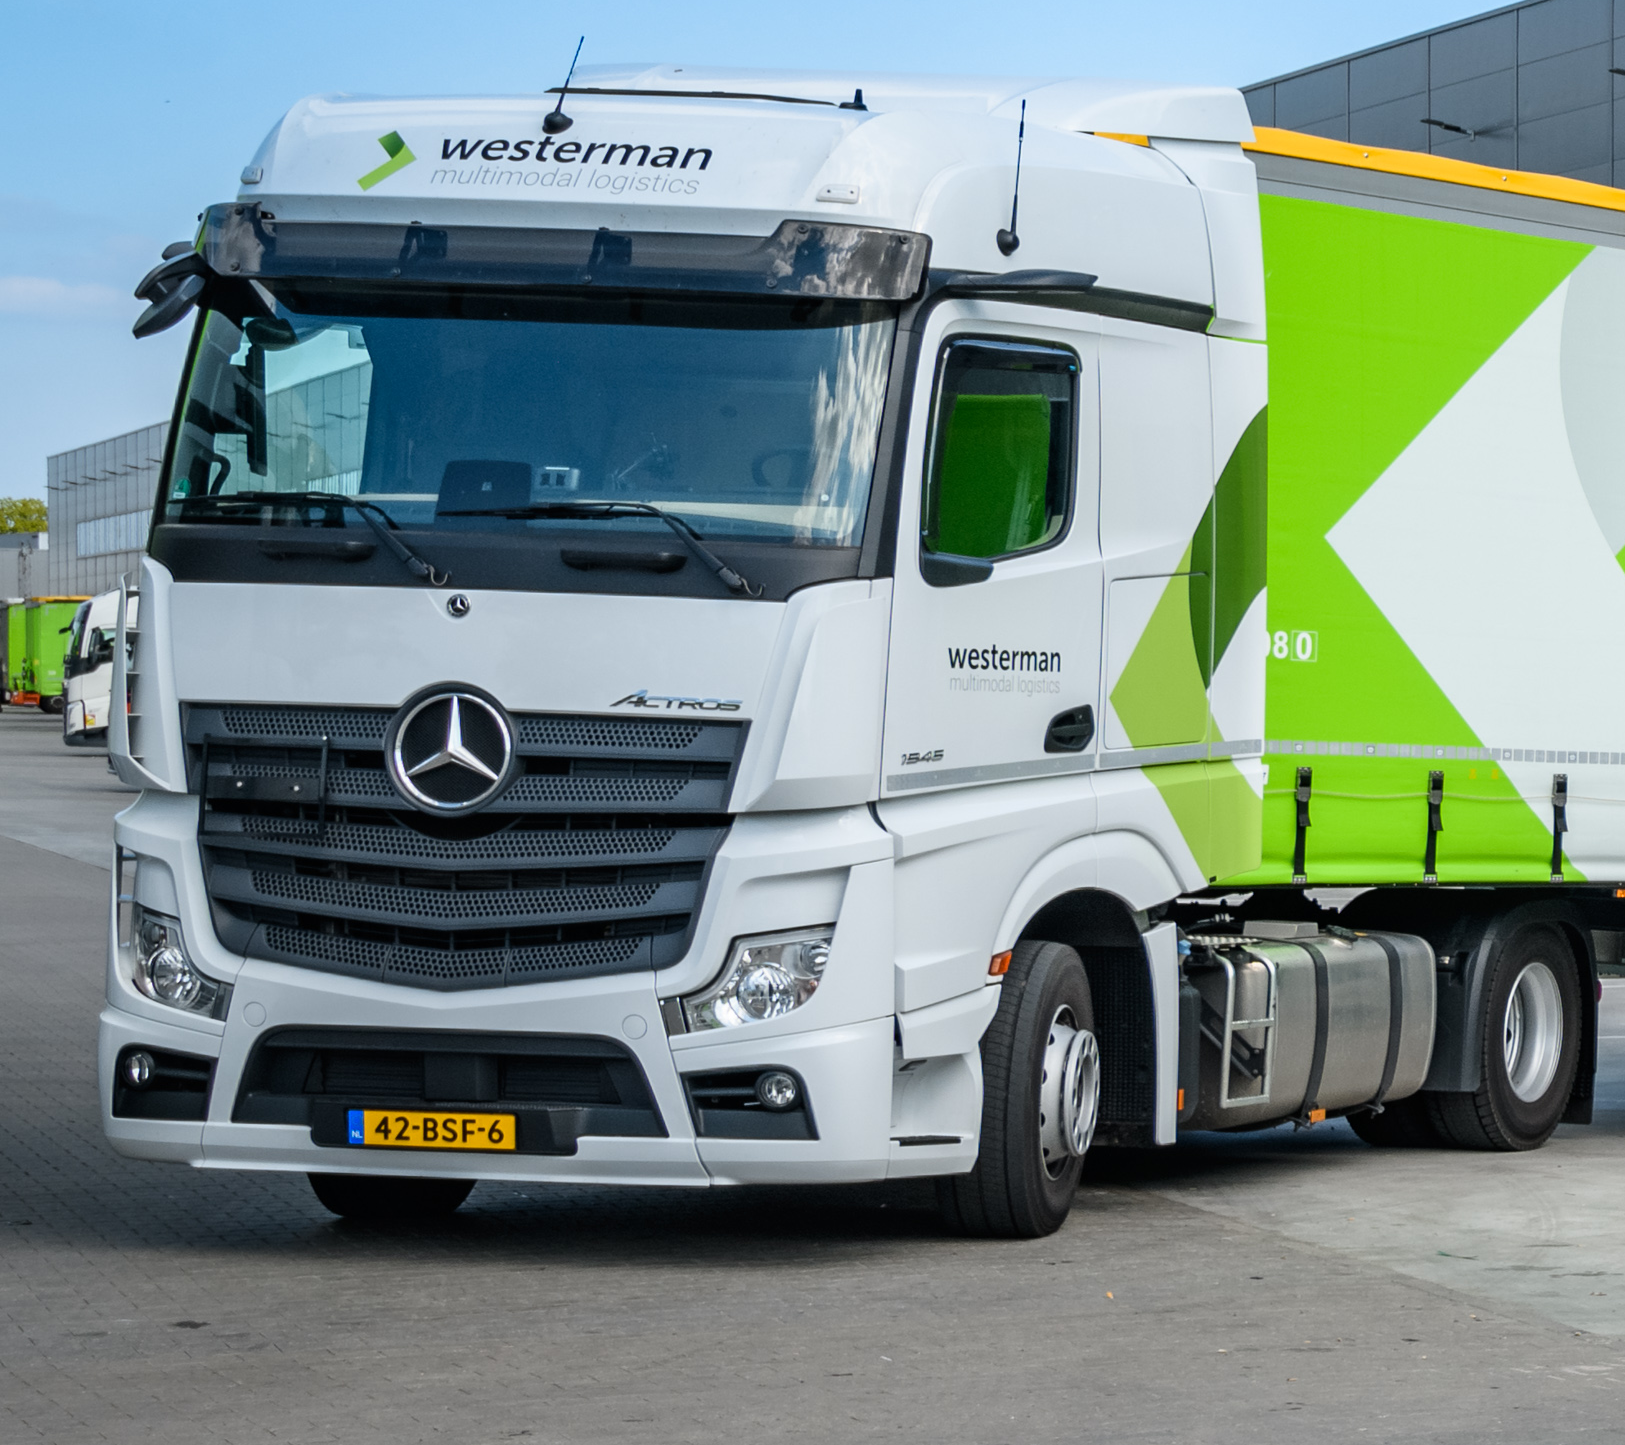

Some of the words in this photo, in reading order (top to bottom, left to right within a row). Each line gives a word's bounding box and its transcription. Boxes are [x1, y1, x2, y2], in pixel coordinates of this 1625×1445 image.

[440, 135, 713, 171] westerman
[430, 165, 582, 188] multimodal
[587, 169, 700, 195] logistics
[948, 644, 1061, 672] westerman
[1266, 630, 1289, 660] 8
[949, 674, 1014, 693] multimodal
[1016, 674, 1061, 697] logistics
[351, 1130, 363, 1139] NL
[374, 1116, 504, 1144] 42-BSF-6
